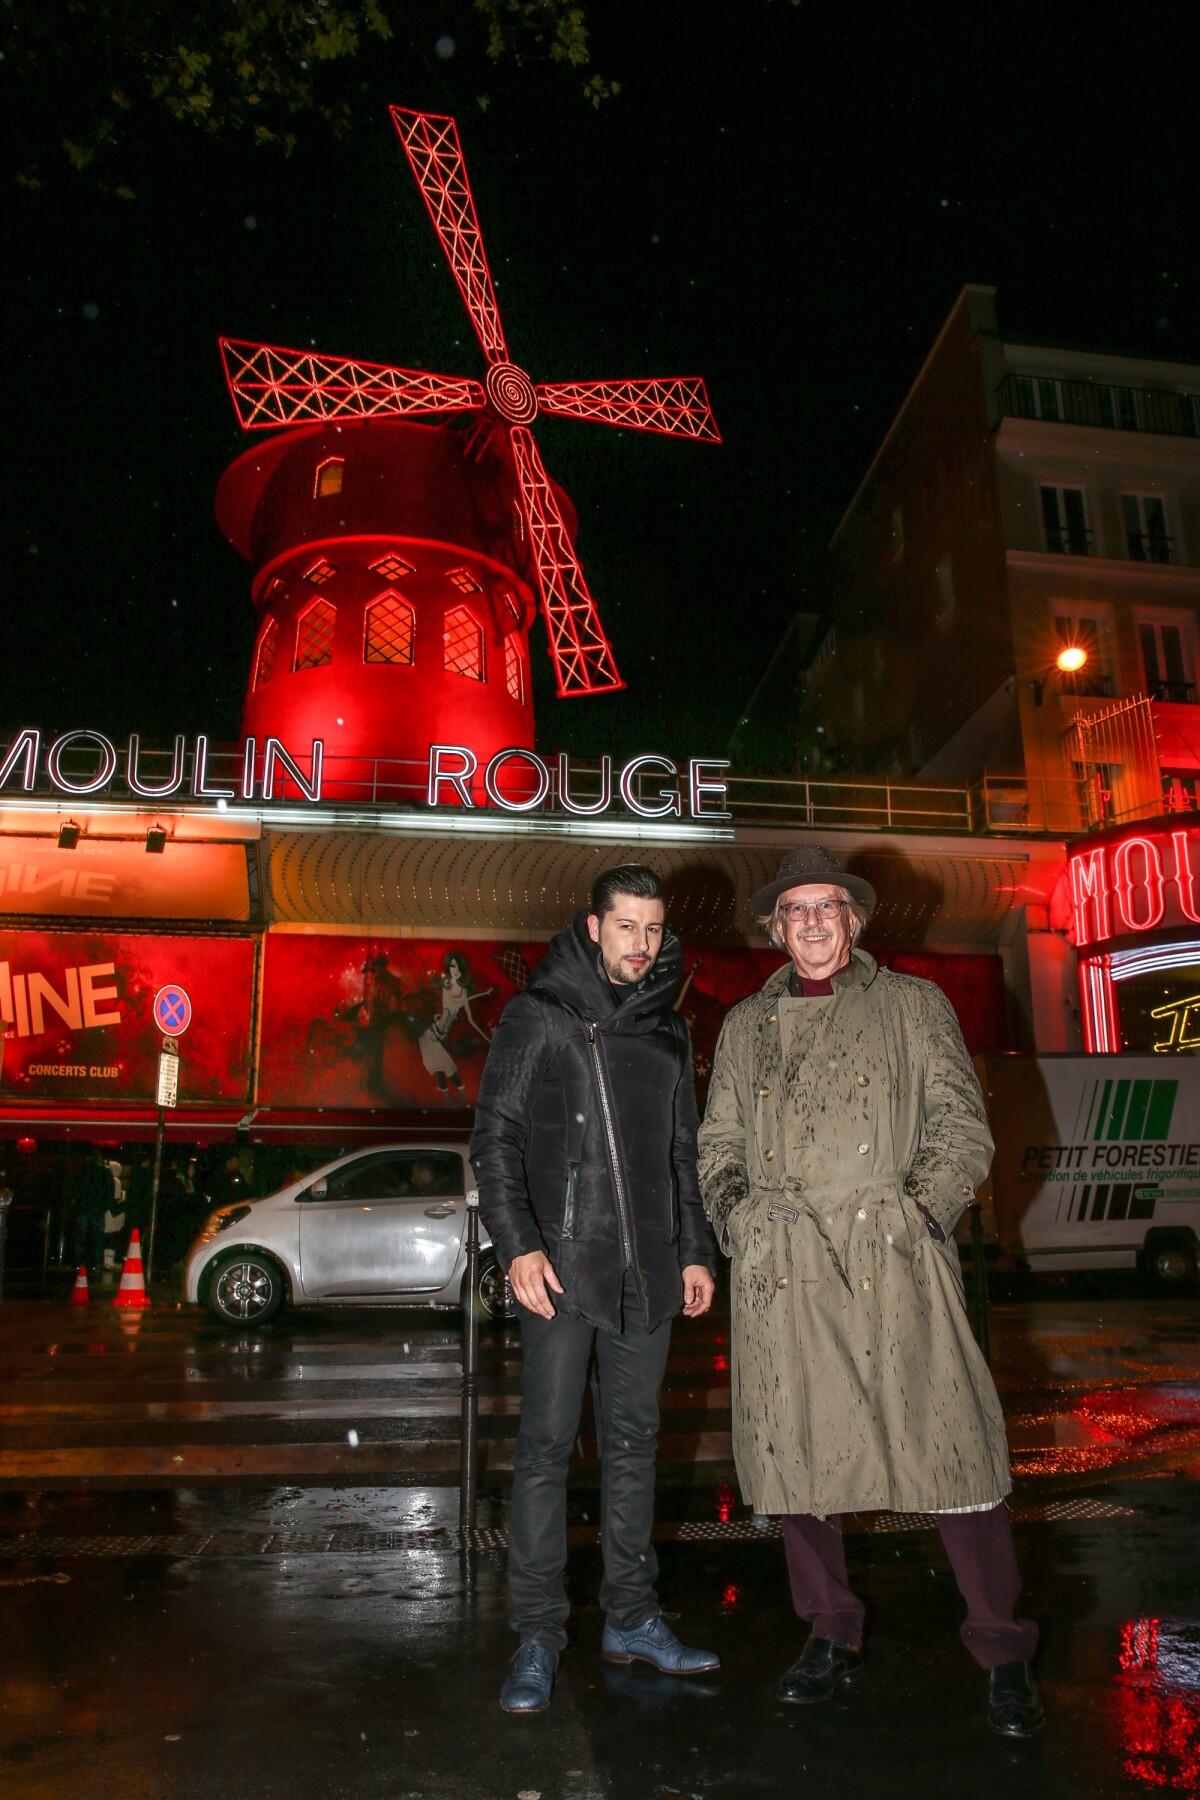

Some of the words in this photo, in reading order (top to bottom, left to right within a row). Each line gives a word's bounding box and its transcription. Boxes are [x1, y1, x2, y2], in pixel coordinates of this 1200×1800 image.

[427, 744, 733, 819] ROUGE
[29, 1064, 87, 1077] CONCERTS
[89, 1065, 119, 1078] CLUB
[1023, 1145, 1088, 1168] PETIT
[1073, 1169, 1088, 1181] de
[1091, 1168, 1143, 1181] véhicules
